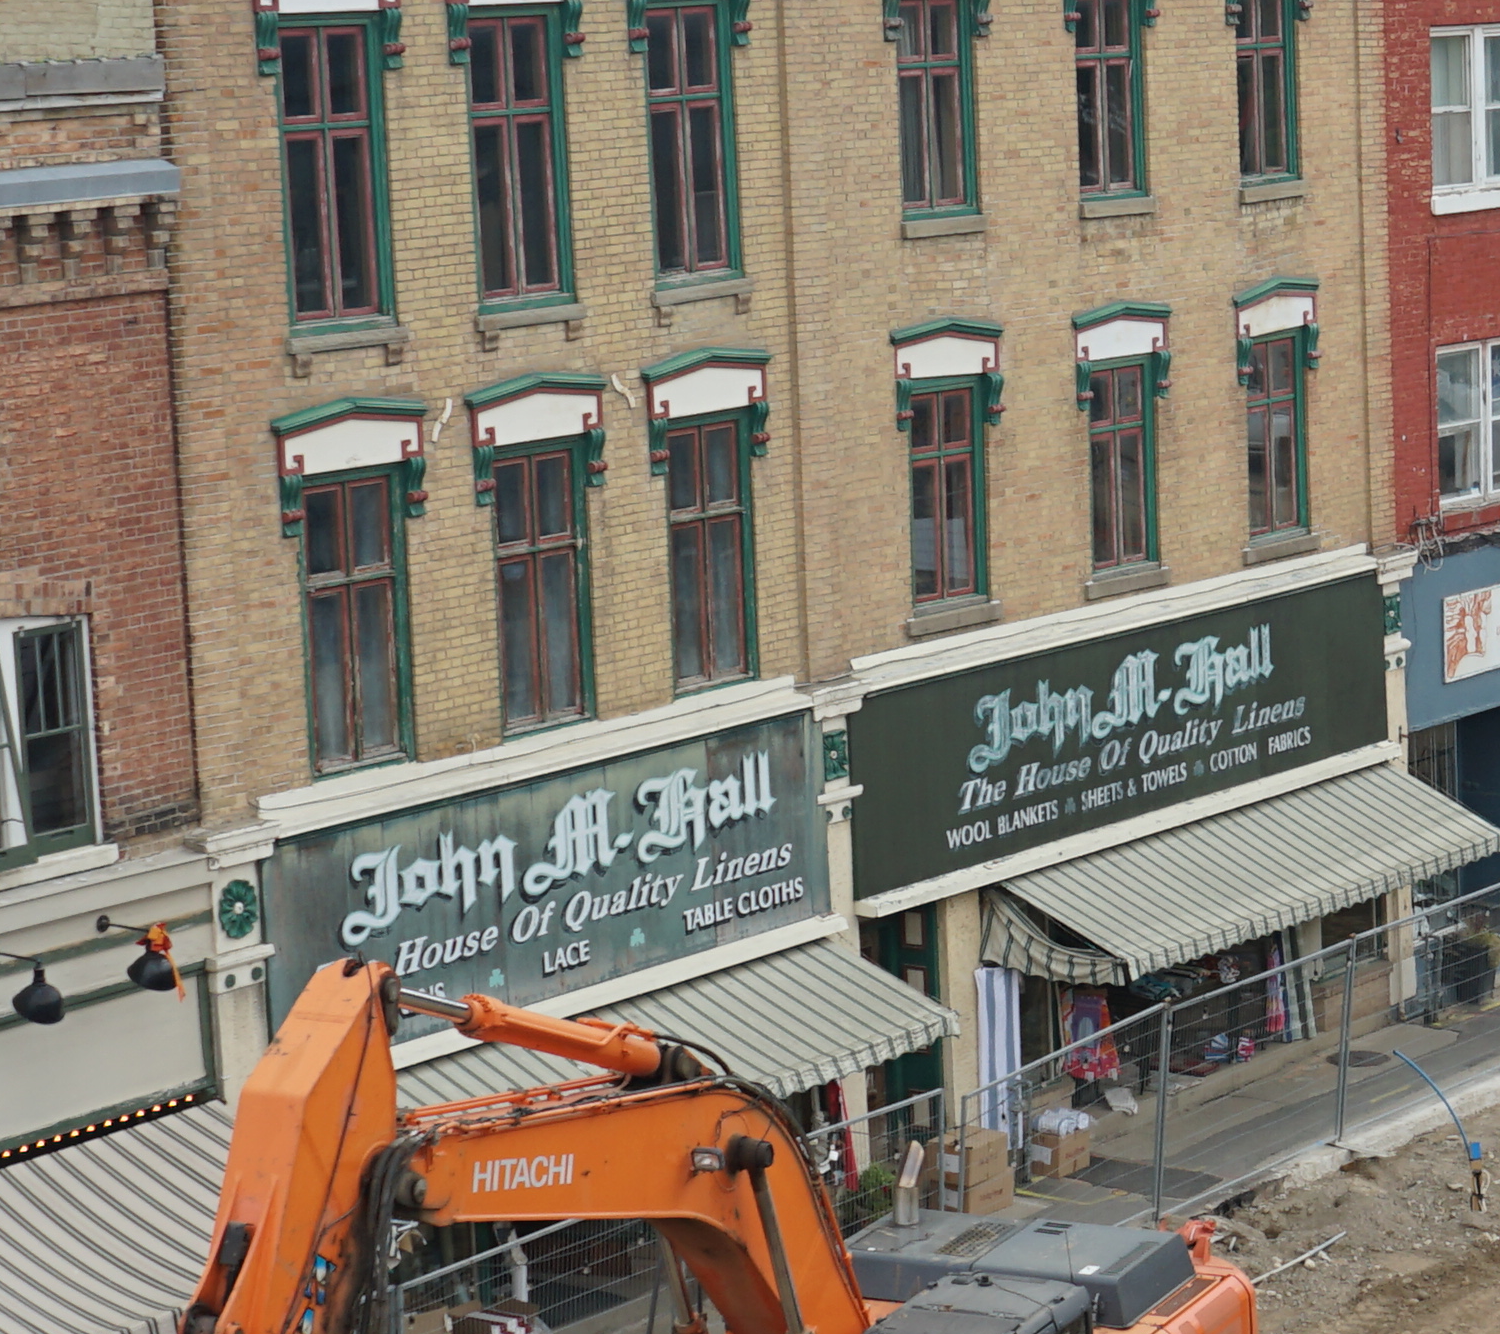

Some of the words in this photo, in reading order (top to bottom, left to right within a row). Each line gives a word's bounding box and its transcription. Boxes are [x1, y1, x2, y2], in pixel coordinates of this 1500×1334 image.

[957, 774, 1007, 815] The
[1015, 752, 1091, 796] House
[1101, 737, 1132, 770] Of
[1137, 718, 1223, 763] Quality
[1232, 695, 1306, 736] Linens
[966, 679, 1093, 774] John
[1174, 624, 1275, 715] Hall
[342, 832, 518, 947] John
[637, 751, 777, 865] Hall
[946, 817, 992, 850] WOOL
[998, 799, 1058, 835] BLANKETS
[1081, 779, 1123, 812] SHEETS
[1127, 777, 1138, 798] &
[1141, 761, 1187, 793] TOWELS
[1209, 741, 1257, 773] COTTON
[1268, 726, 1312, 755] FABRICS
[396, 924, 498, 977] House
[512, 902, 555, 947] Of
[564, 870, 684, 933] Quality
[690, 843, 793, 893] Linens
[542, 939, 592, 976] LACE
[683, 898, 733, 932] TABLE
[737, 876, 804, 916] CLOTHS
[471, 1153, 574, 1194] HITACHI
